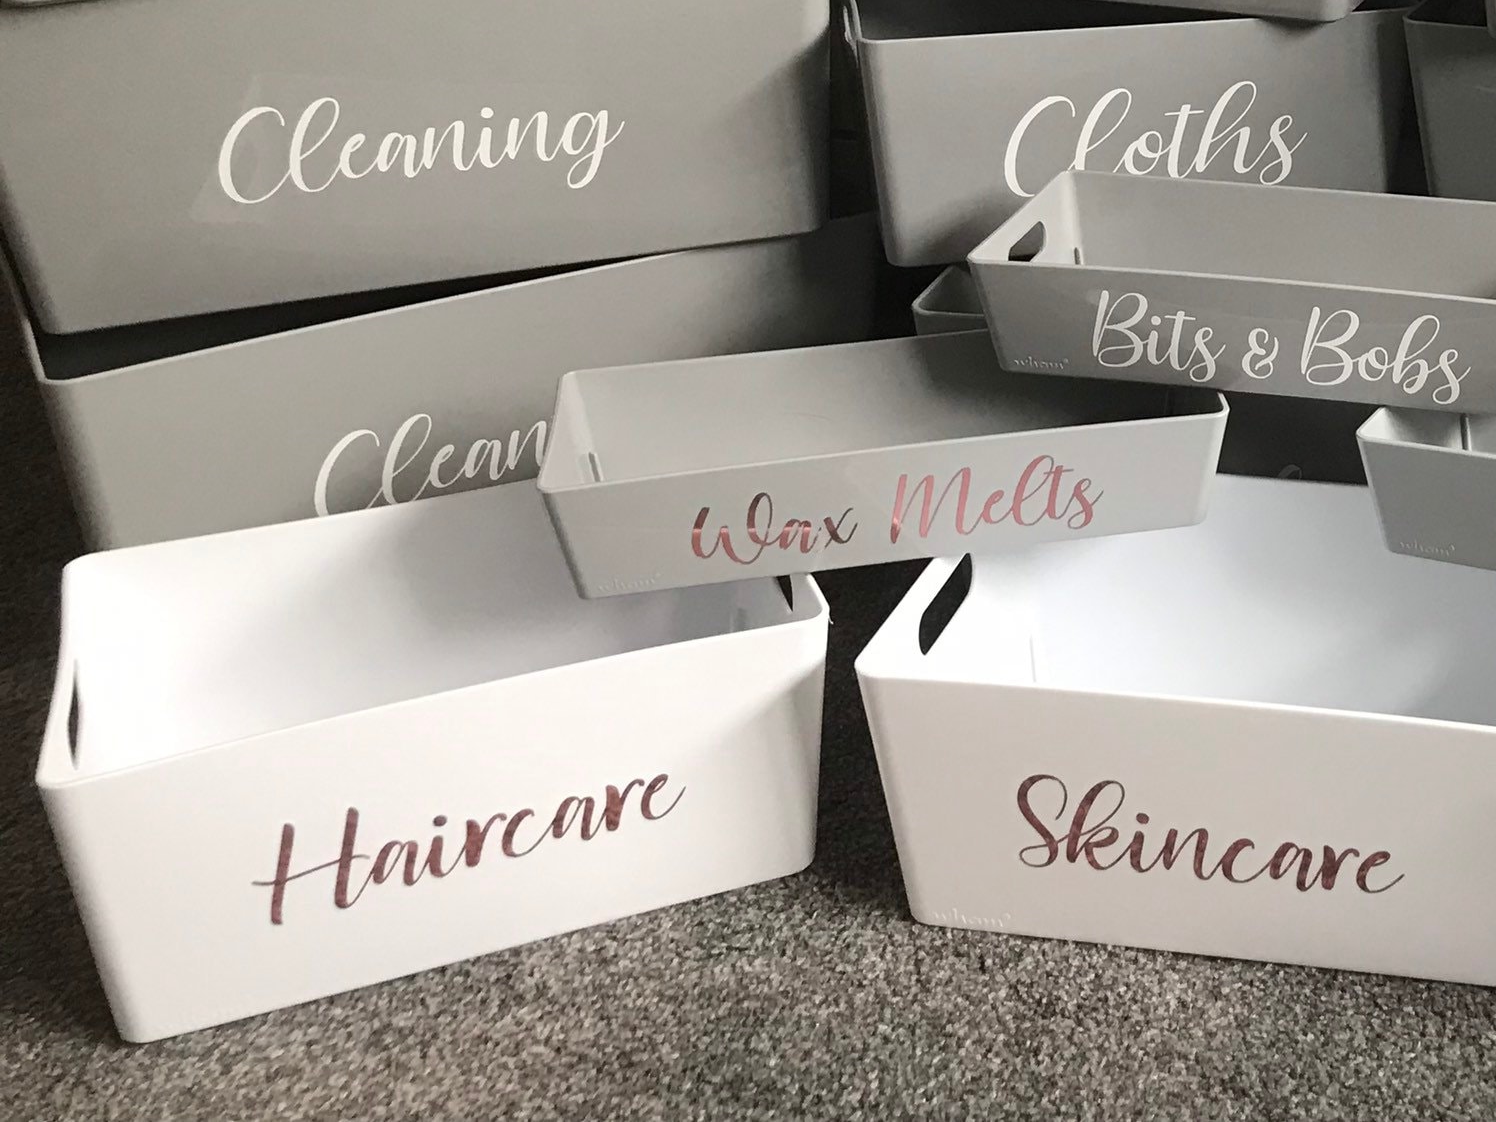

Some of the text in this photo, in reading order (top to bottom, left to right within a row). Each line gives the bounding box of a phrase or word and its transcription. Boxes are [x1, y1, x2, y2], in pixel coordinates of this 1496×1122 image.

[218, 97, 625, 204] Cleaning
[1004, 81, 1308, 197] Cloths
[1092, 290, 1471, 405] Bits & Bobs
[314, 413, 547, 517] Clean
[691, 454, 1104, 565] Wax Melts
[253, 773, 685, 925] Haircare
[1017, 774, 1404, 893] Skincare
